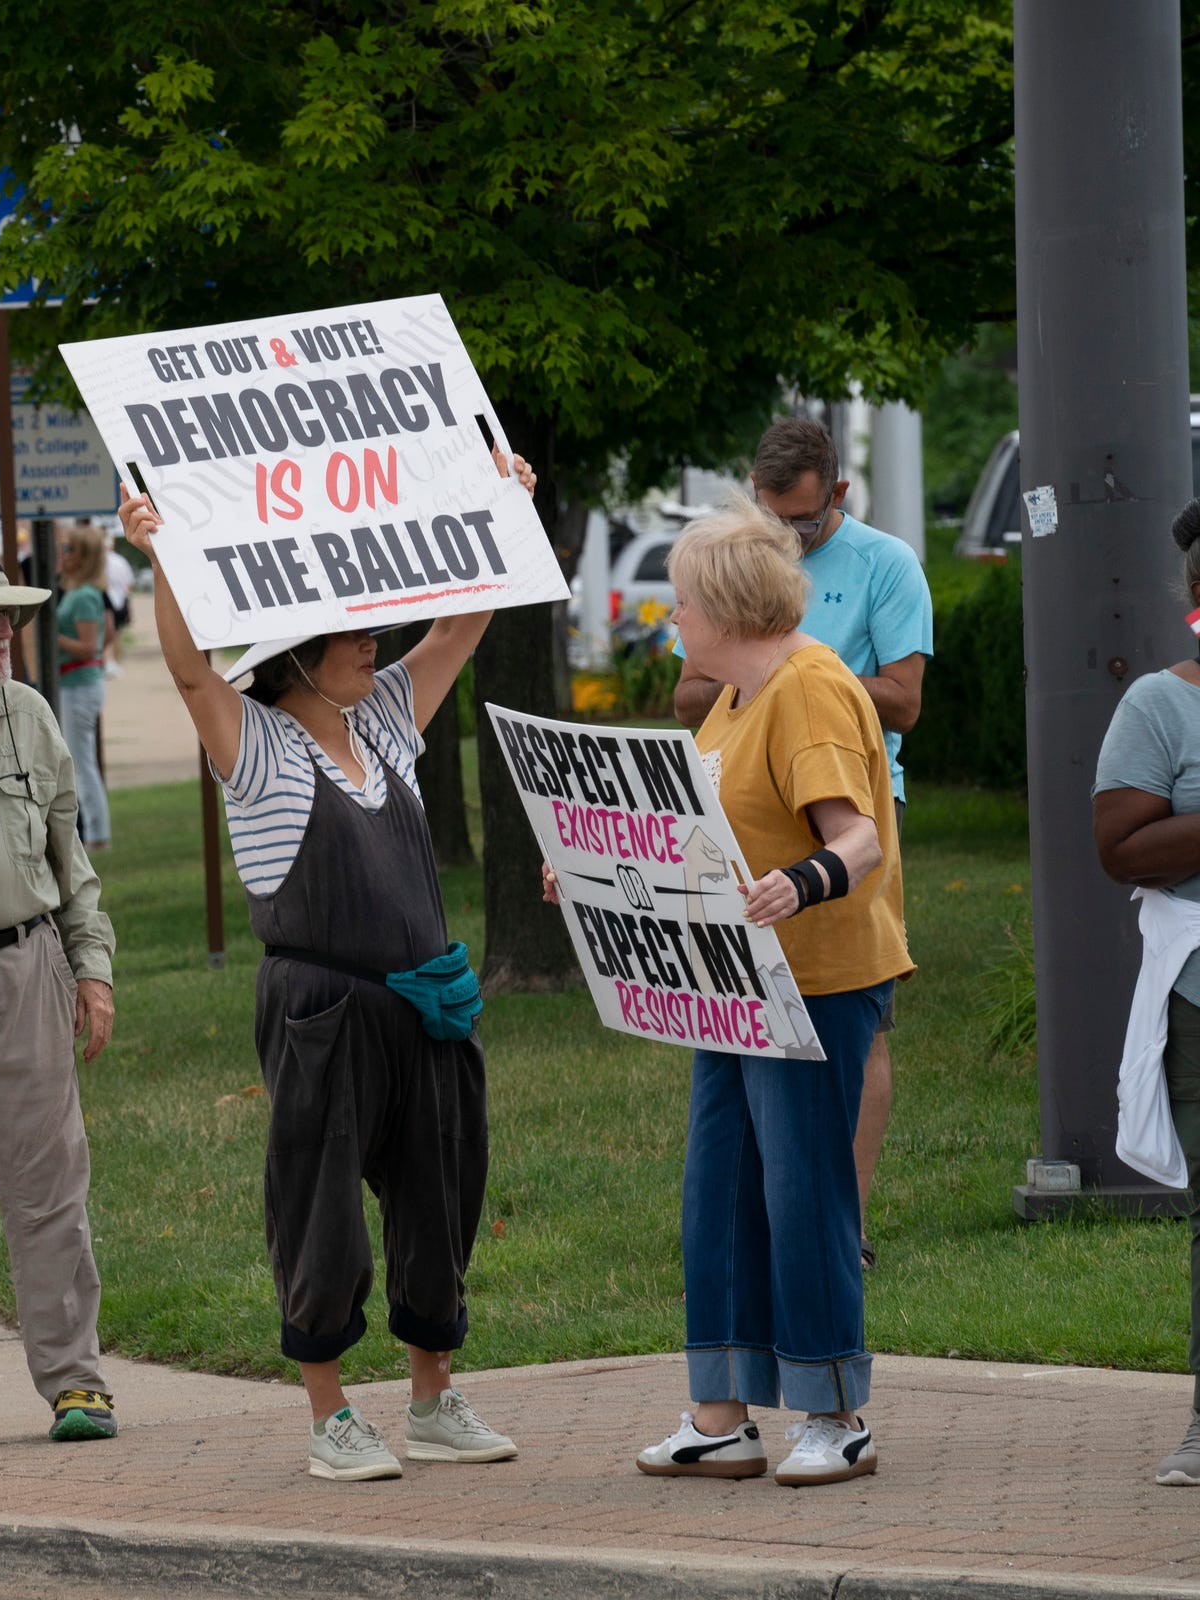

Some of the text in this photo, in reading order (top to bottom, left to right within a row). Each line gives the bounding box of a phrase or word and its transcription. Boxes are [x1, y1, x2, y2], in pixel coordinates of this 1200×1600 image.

[146, 343, 205, 383] GET
[204, 335, 267, 376] OUT
[269, 337, 299, 368] &
[290, 319, 385, 363] VOTE!
[35, 438, 89, 455] College
[124, 362, 458, 468] DEMOCRACY
[255, 458, 303, 525] IS
[325, 444, 399, 513] ON
[203, 537, 321, 612] THE
[310, 510, 508, 599] BALLOT
[496, 716, 705, 817] RESPECT MY
[551, 800, 684, 865] EXISTENCE
[616, 864, 655, 911] OR
[572, 901, 767, 1000] EXPECT MY
[615, 980, 770, 1050] RESISTANCE
